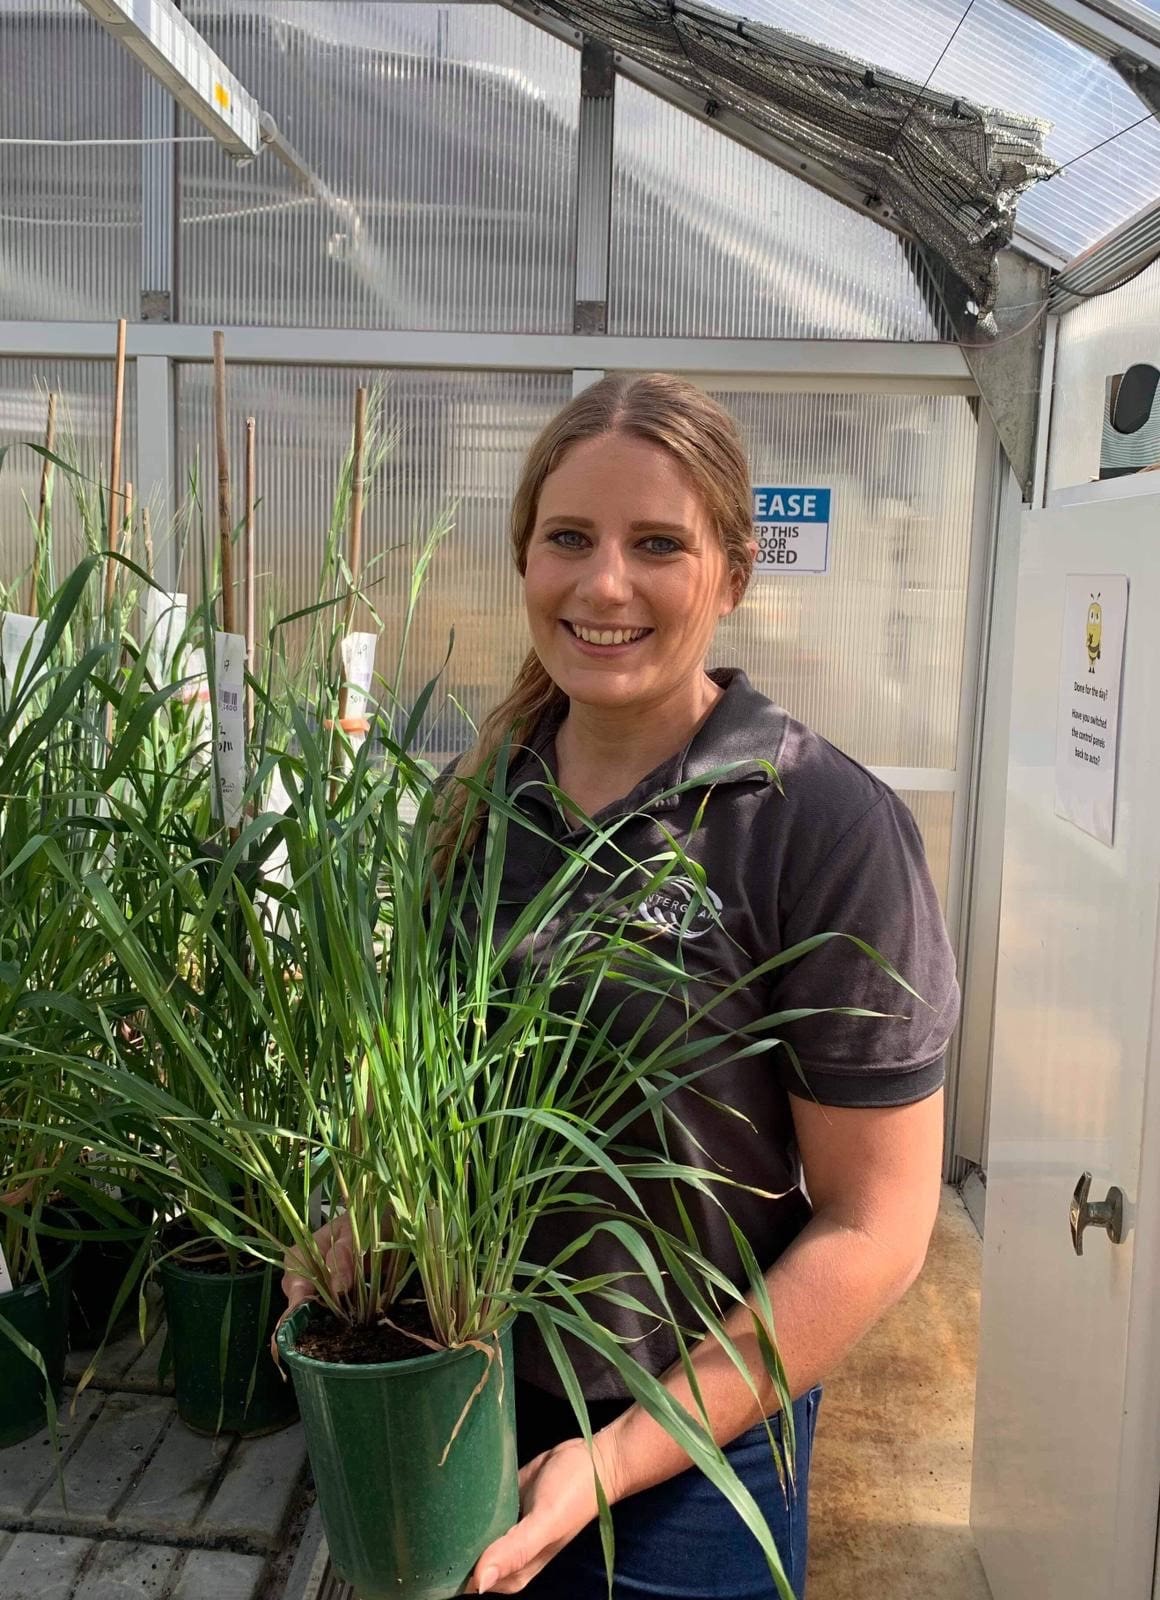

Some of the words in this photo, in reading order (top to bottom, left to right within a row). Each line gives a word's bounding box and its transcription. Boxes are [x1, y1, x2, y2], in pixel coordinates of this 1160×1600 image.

[754, 494, 817, 517] EASE
[754, 526, 769, 538] EP
[771, 526, 799, 538] THIS
[758, 538, 786, 549] OOR
[755, 550, 798, 564] OSED
[1074, 681, 1085, 694] Done
[1099, 688, 1108, 701] day?
[1072, 708, 1082, 720] Have
[1090, 716, 1107, 729] switched
[1071, 726, 1079, 738] the
[1079, 732, 1093, 743] control
[1093, 737, 1106, 749] panels
[1075, 747, 1084, 759] back
[1084, 751, 1089, 761] to
